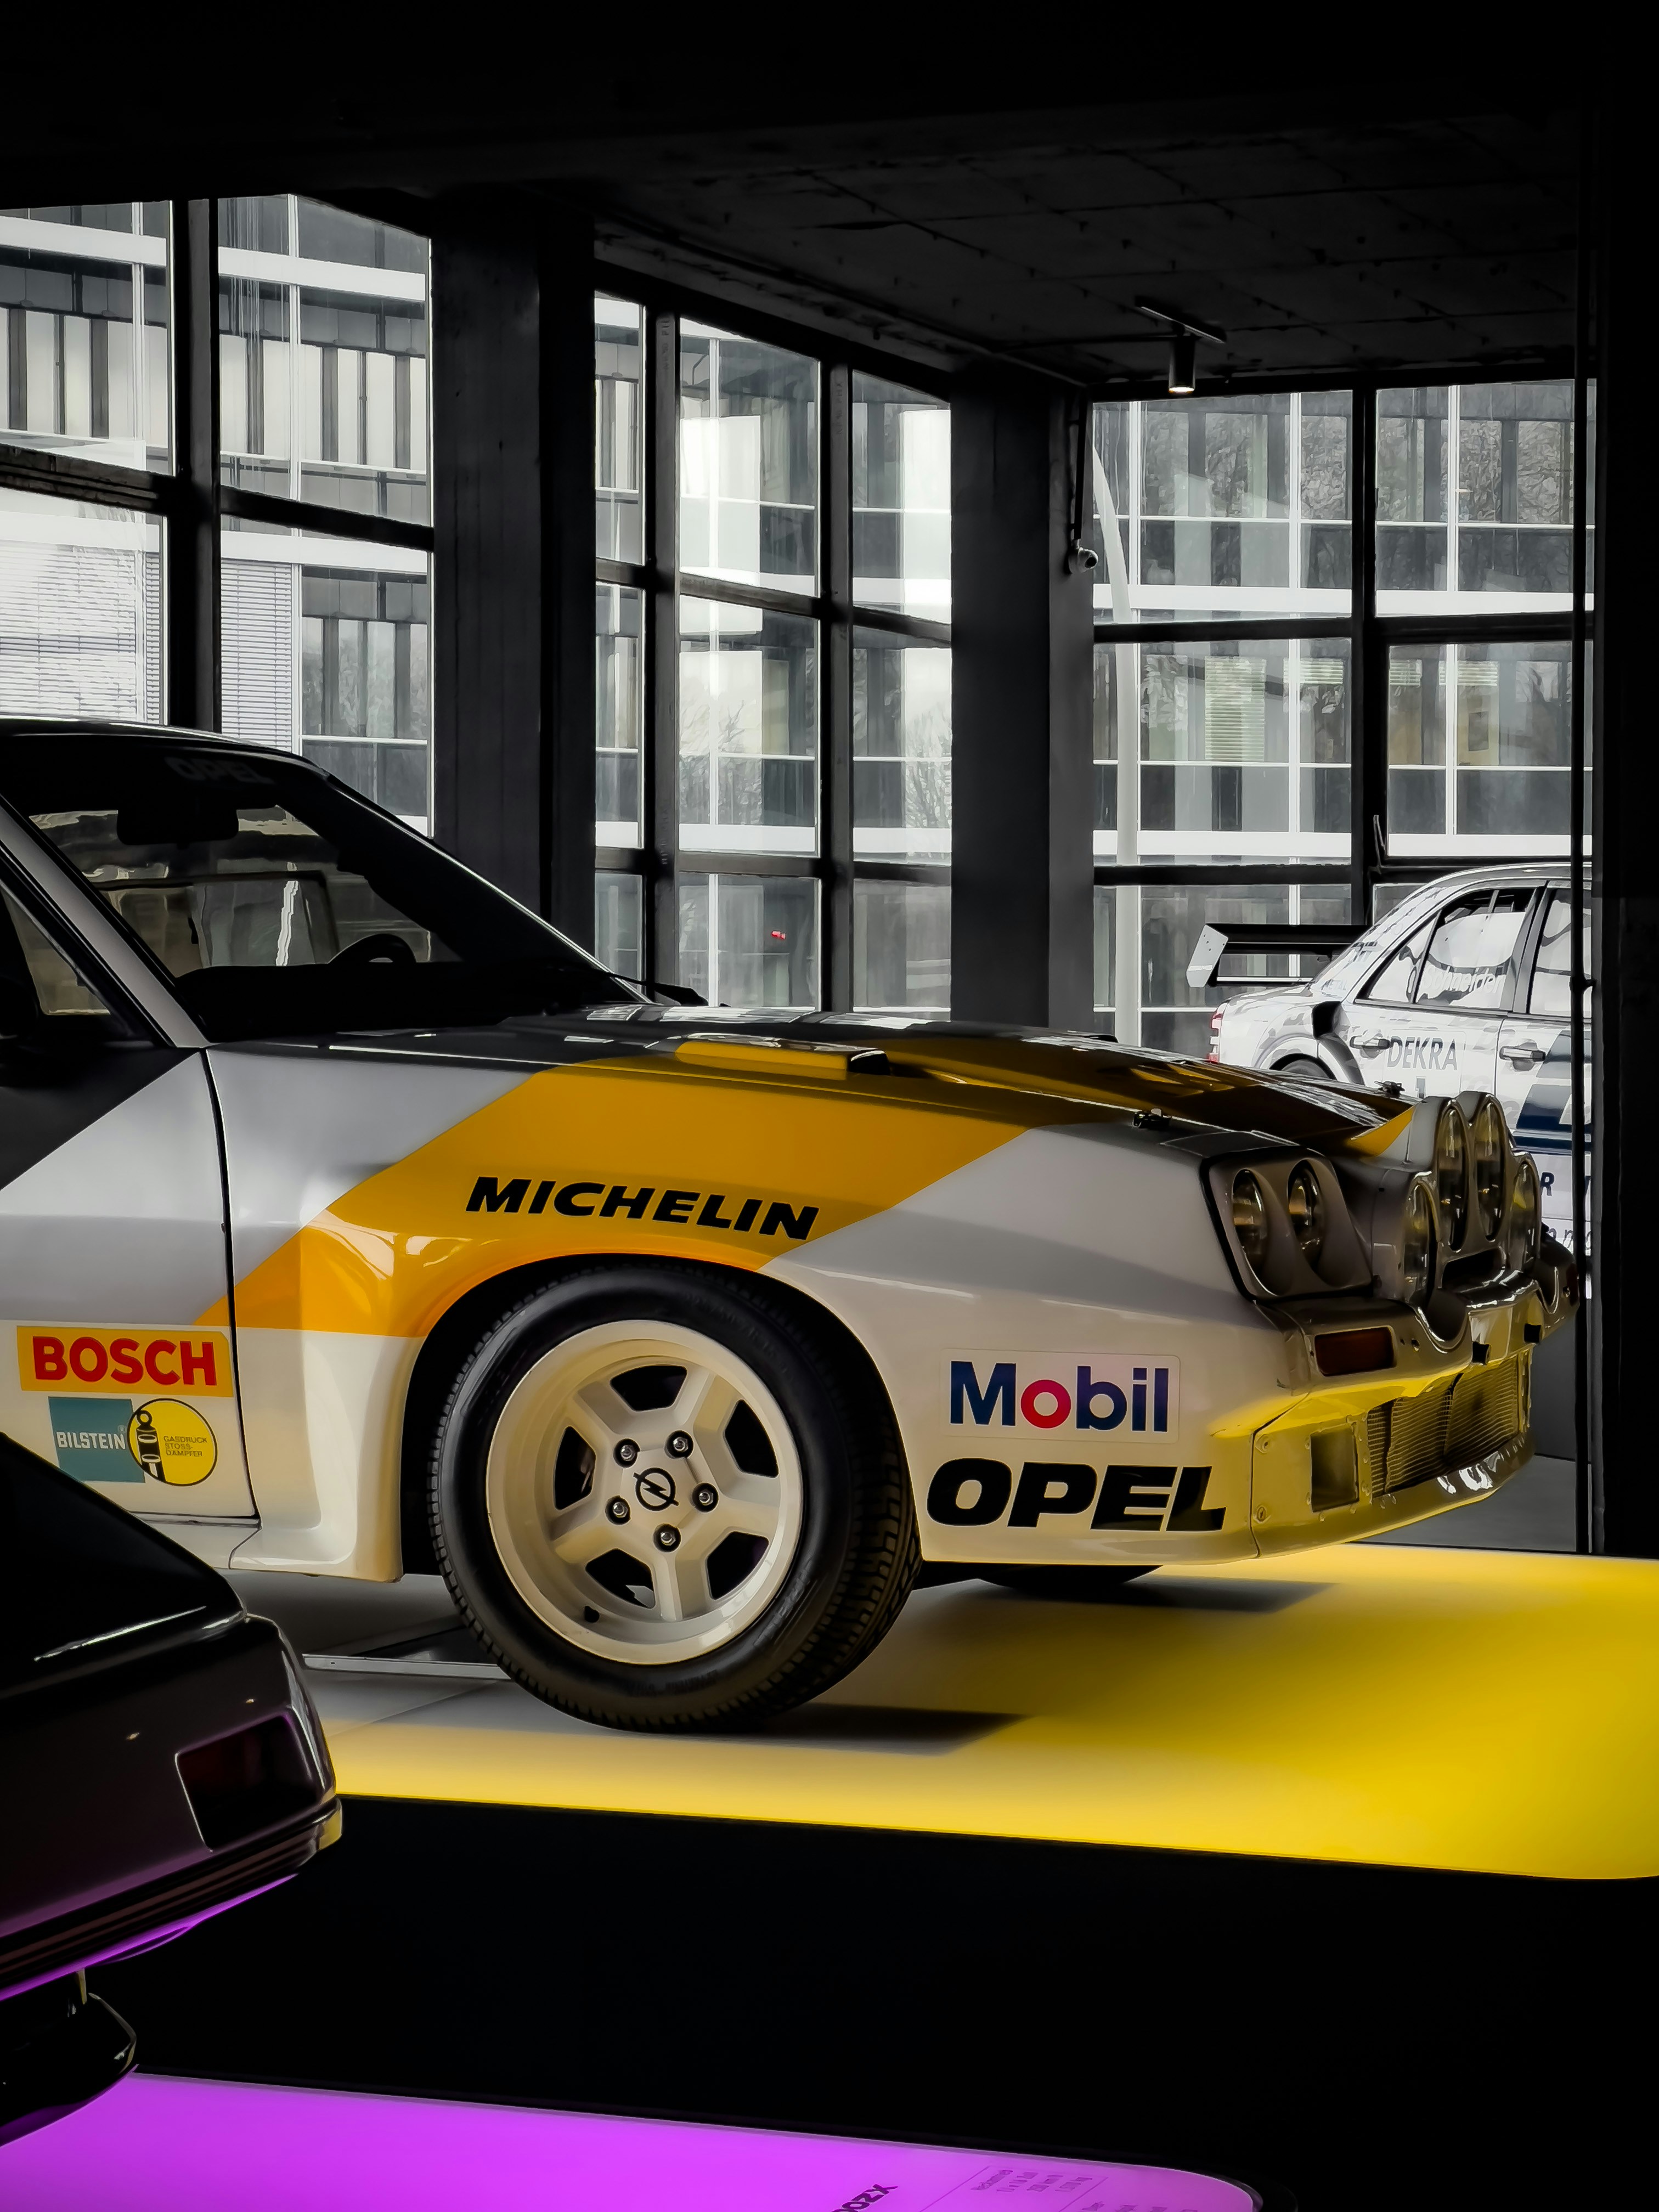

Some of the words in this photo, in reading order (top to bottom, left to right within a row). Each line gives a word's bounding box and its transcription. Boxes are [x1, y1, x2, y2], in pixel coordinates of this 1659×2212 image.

[163, 757, 276, 785] OPEL
[1424, 966, 1506, 994] Schneider
[1387, 1036, 1457, 1070] DEKRA
[465, 1176, 819, 1240] MICHELIN
[33, 1336, 217, 1386] BOSCH
[950, 1360, 1170, 1432] Mobil
[57, 1431, 126, 1450] BILSTEIN
[927, 1457, 1227, 1532] OPEL
